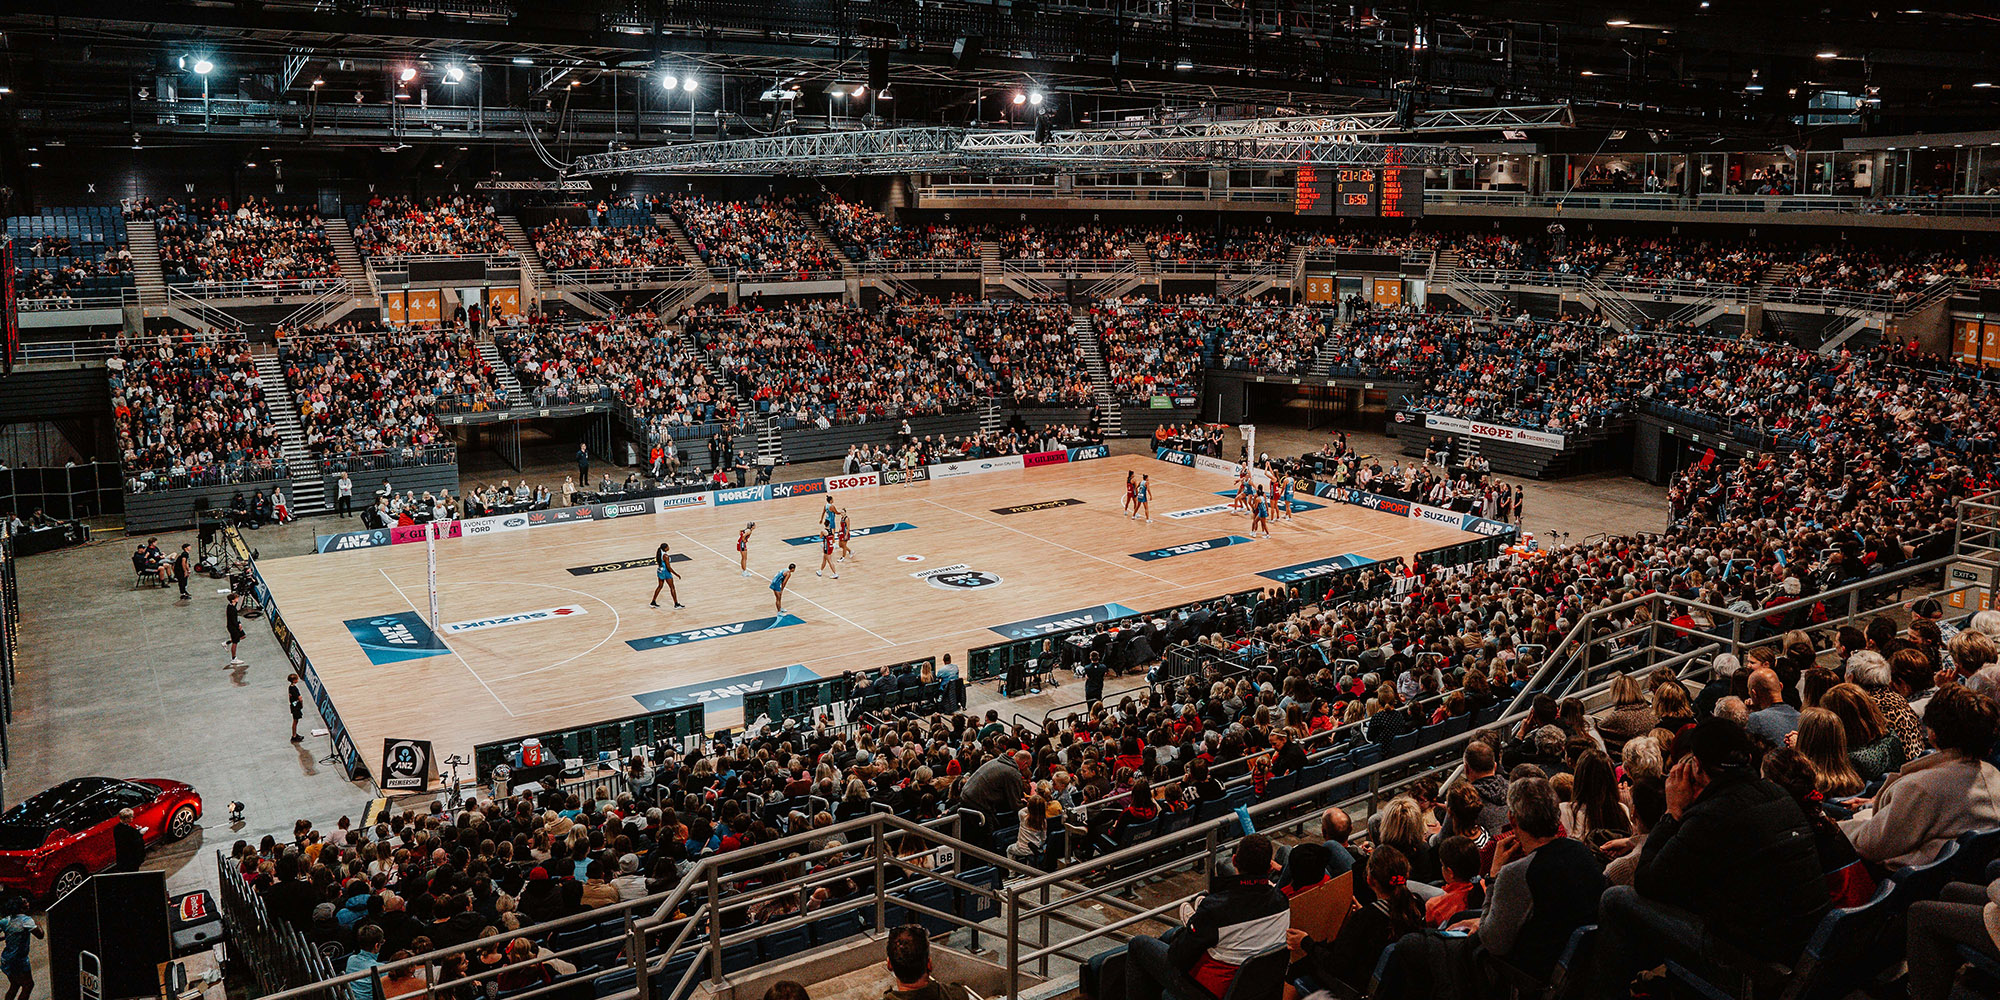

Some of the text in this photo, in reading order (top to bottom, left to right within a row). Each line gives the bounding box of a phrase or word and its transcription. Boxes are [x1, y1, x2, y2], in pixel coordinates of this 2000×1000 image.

[1341, 170, 1353, 181] 21
[1361, 170, 1373, 181] 26
[1349, 194, 1367, 205] 6:56
[1309, 282, 1317, 293] 3
[1322, 283, 1330, 293] 3
[1377, 285, 1385, 296] 3
[1390, 286, 1398, 297] 3
[391, 299, 402, 311] 4
[410, 298, 421, 310] 4
[426, 297, 437, 309] 4
[506, 294, 517, 305] 4
[1968, 329, 1977, 343] 2
[1986, 332, 1995, 346] 2
[1471, 424, 1513, 439] SKOPE
[1034, 453, 1066, 464] GILBERT
[1078, 448, 1098, 460] ANZ
[1164, 451, 1185, 465] ANZ
[829, 475, 877, 490] SKOPE
[773, 481, 823, 497] sky SPORT
[663, 496, 698, 506] RITCHIES
[1362, 494, 1409, 515] sky SPORT
[606, 504, 644, 515] GO MEDIA
[1423, 510, 1460, 526] SUZUKI
[470, 525, 491, 533] FORD
[1474, 521, 1503, 536] ANZ
[336, 532, 371, 550] ANZ
[1165, 540, 1212, 556] ANZ
[1953, 570, 1969, 579] EXIT
[1953, 593, 1961, 603] E
[452, 612, 548, 631] SUZUKI
[1034, 614, 1095, 634] ANZ
[377, 623, 419, 645] ANZ
[680, 623, 745, 641] ANZ
[687, 679, 764, 703] ANZ
[395, 761, 413, 770] ANZ
[388, 778, 421, 788] PREMIERSHIP
[940, 852, 954, 864] BB
[82, 974, 99, 991] 100
